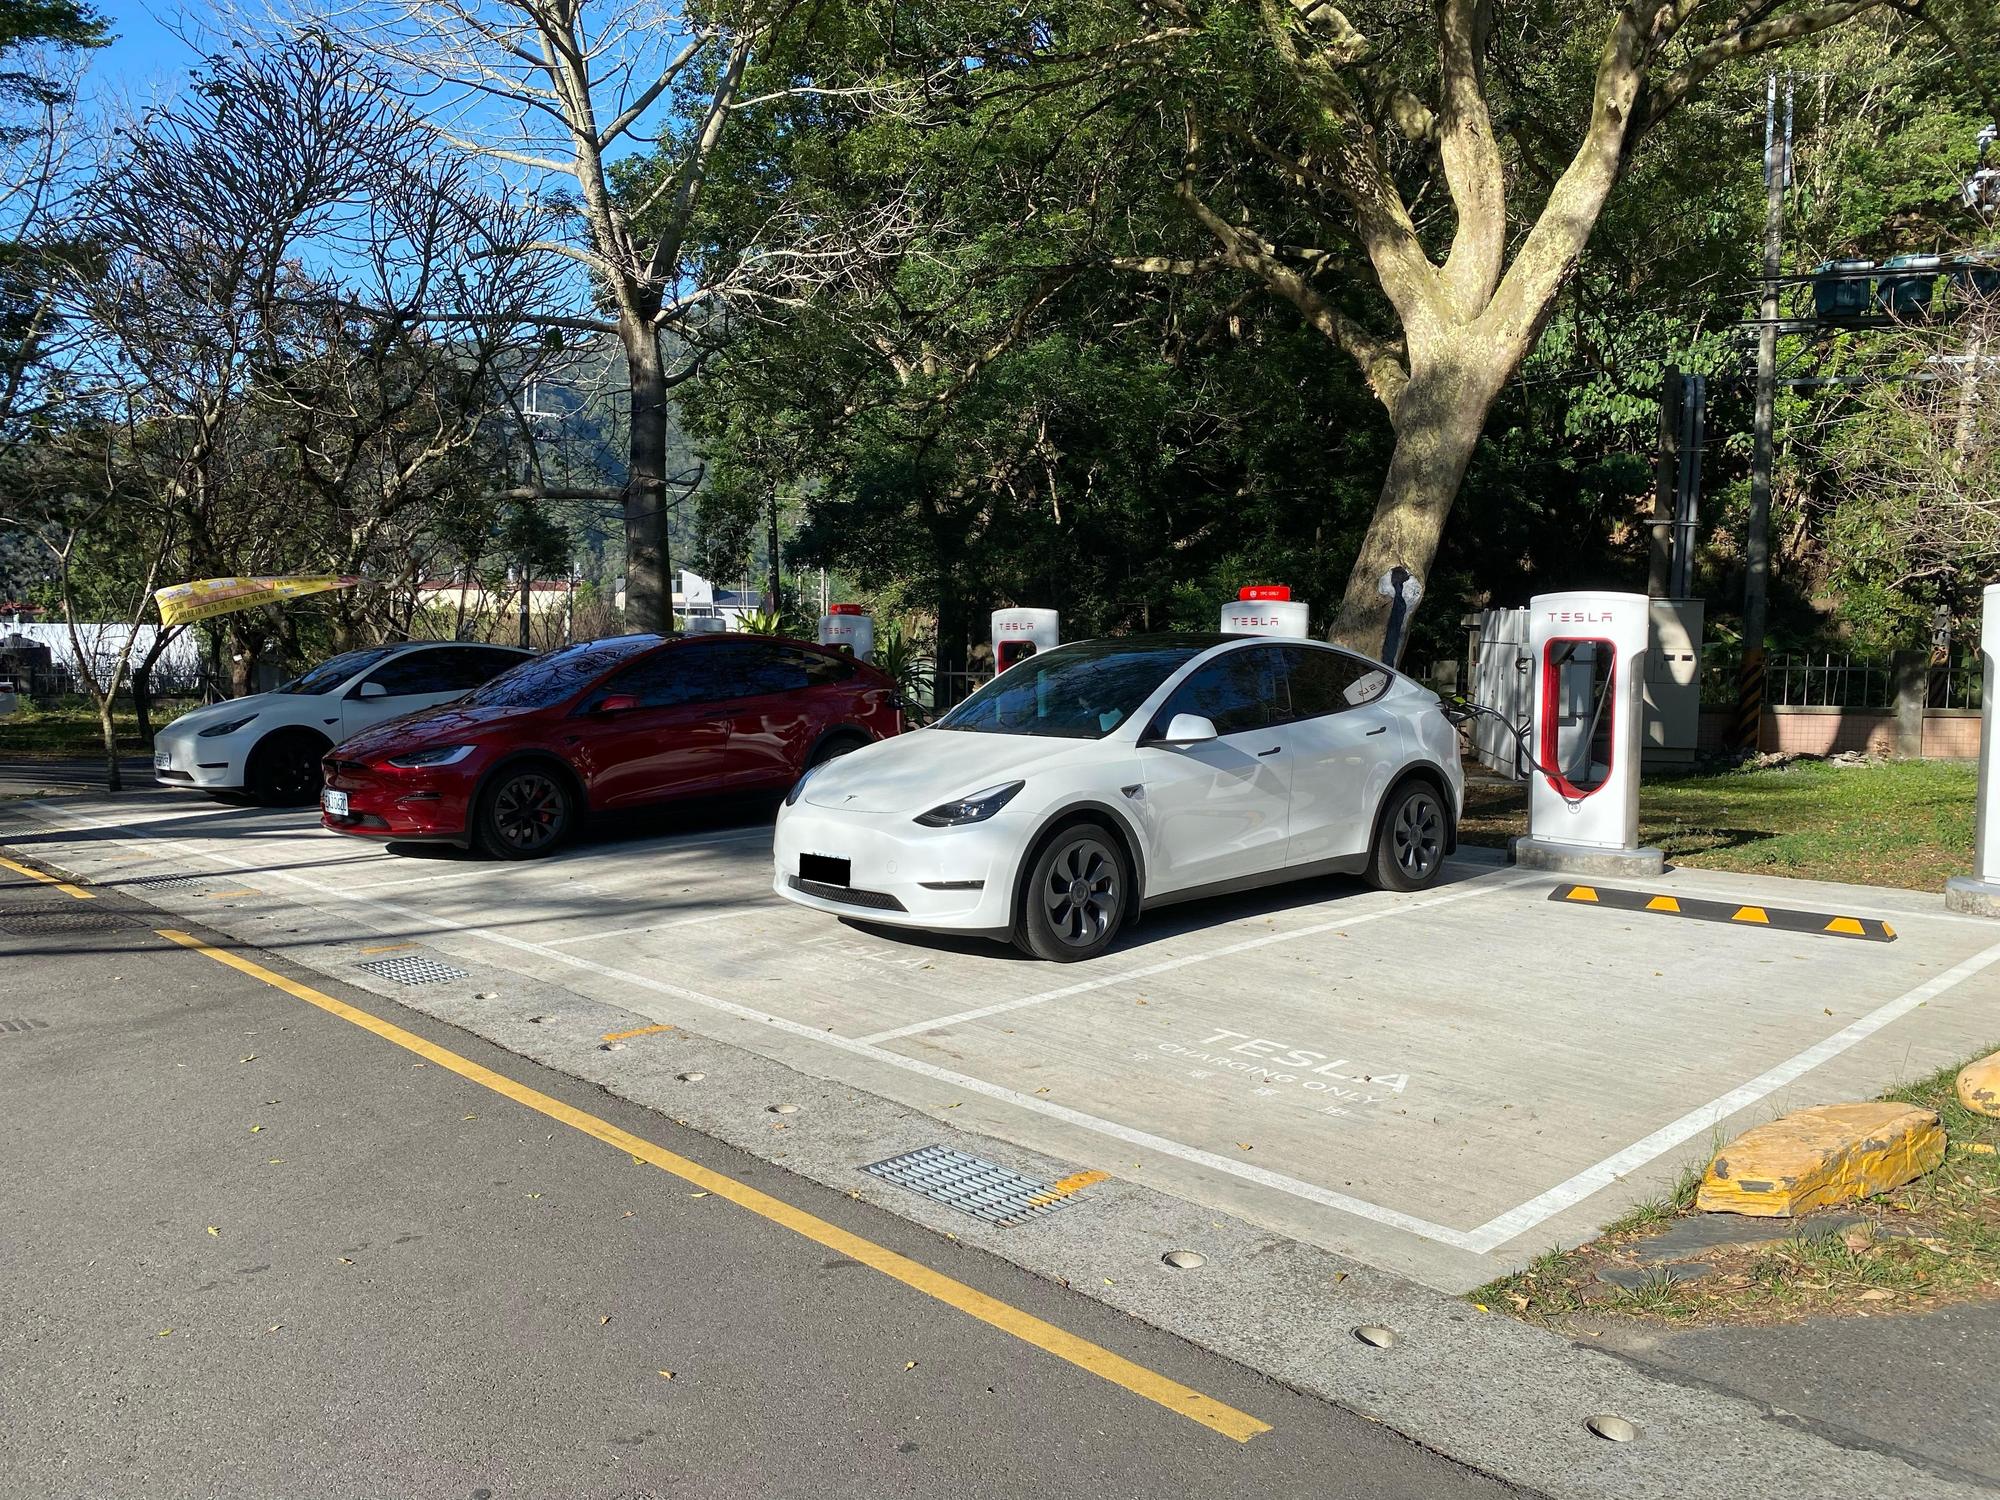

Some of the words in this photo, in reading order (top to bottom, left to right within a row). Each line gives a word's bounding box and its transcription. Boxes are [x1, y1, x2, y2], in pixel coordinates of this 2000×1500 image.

[1232, 617, 1278, 626] TESLA
[1548, 612, 1612, 622] TESLA
[999, 622, 1033, 630] TESLA
[823, 627, 851, 635] TESLA
[1200, 1028, 1410, 1093] TESLA
[1158, 1043, 1298, 1083] CHARGING
[1302, 1081, 1384, 1104] ONLY
